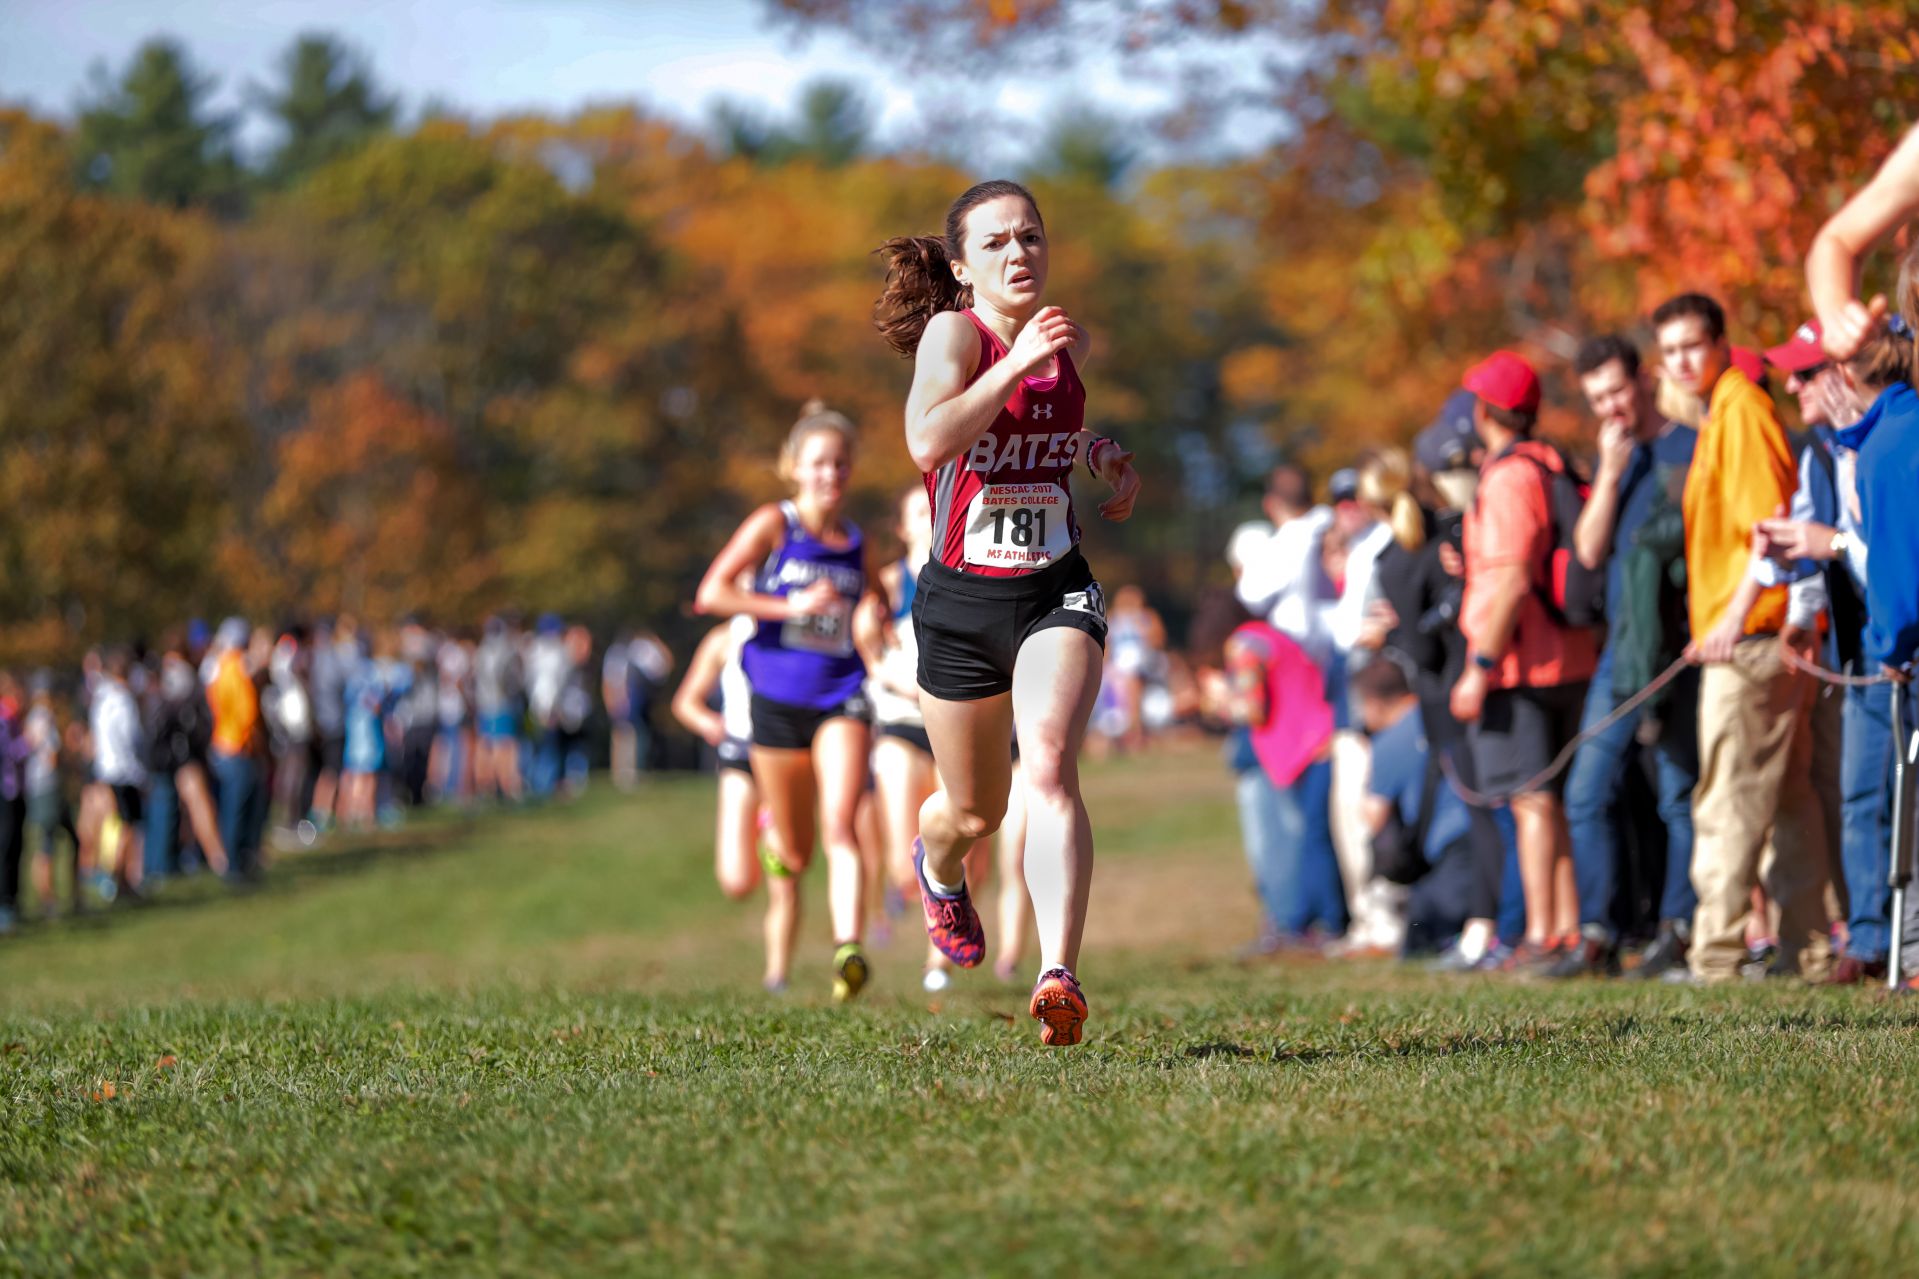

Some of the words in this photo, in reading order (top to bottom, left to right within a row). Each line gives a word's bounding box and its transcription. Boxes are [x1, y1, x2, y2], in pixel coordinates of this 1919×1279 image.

[965, 431, 1081, 472] BATES
[989, 485, 1030, 495] NESCAC
[1032, 485, 1053, 494] 2017
[982, 496, 1018, 505] BATES
[1020, 496, 1059, 505] COLLEGE
[989, 508, 1046, 547] 181
[1003, 550, 1052, 561] ATHLETIC
